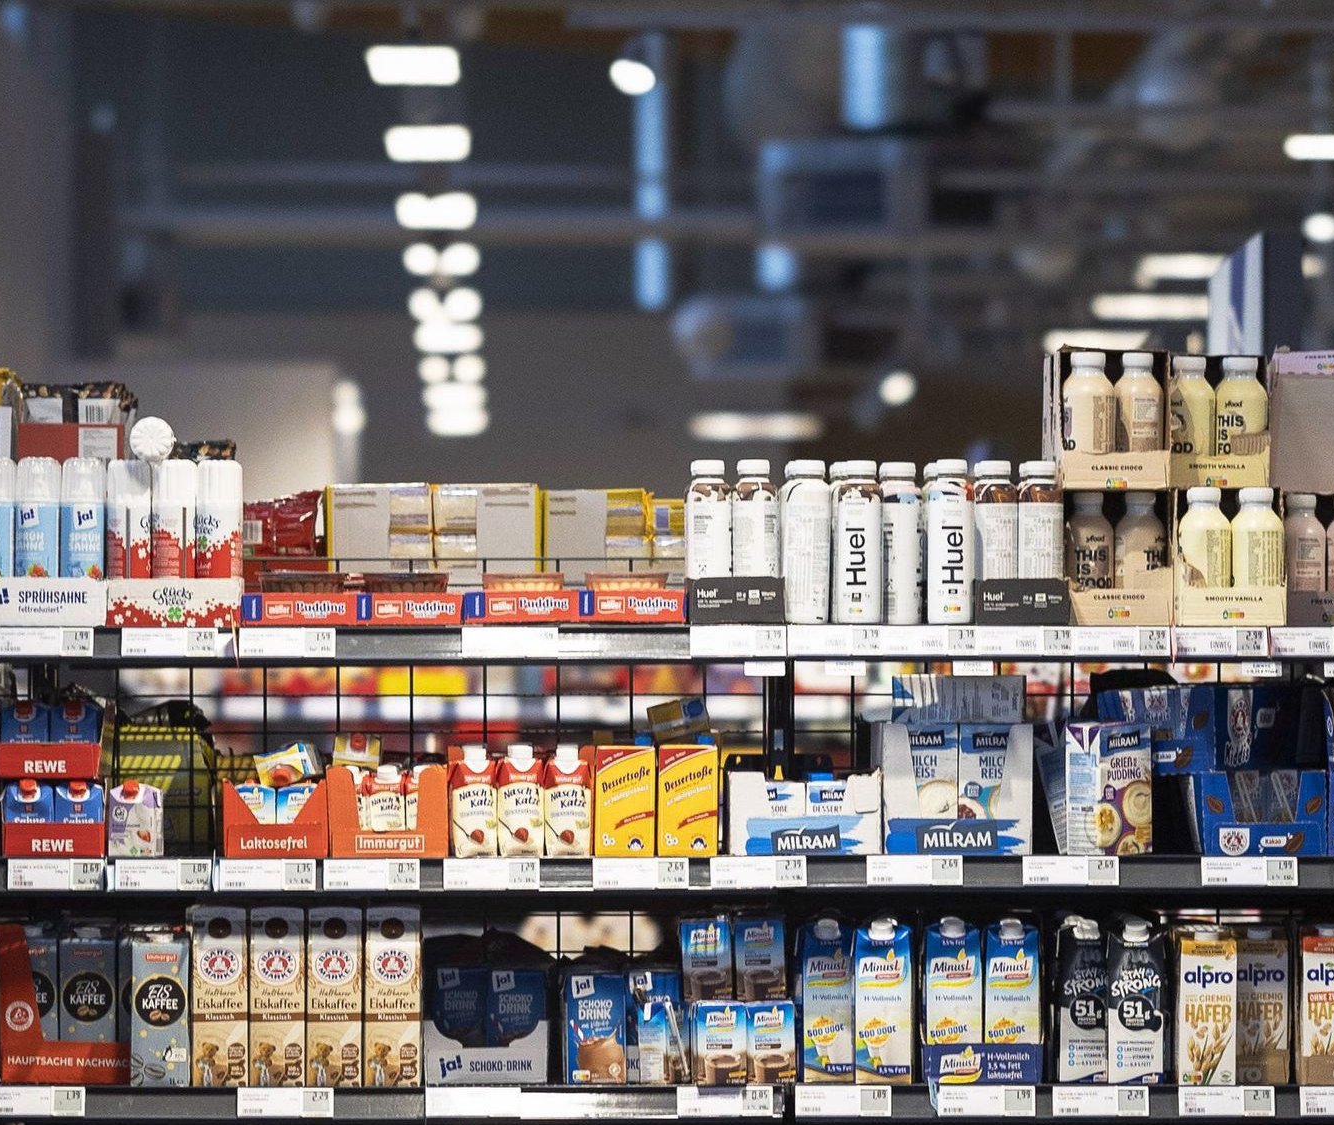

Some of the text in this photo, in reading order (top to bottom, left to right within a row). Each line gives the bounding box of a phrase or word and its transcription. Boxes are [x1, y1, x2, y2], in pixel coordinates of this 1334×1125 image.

[1218, 416, 1244, 427] THIS
[846, 527, 866, 586] Huel
[942, 526, 964, 584] Huel
[18, 588, 88, 604] SPRÜHSAHNE
[697, 588, 718, 599] Huel
[405, 601, 455, 615] Pudding
[1108, 736, 1138, 750] MILRAM
[24, 760, 67, 774] REWE
[1107, 766, 1141, 781] PUDDING
[601, 766, 651, 793] Dessertsoße
[458, 788, 486, 801] Nasch
[31, 838, 74, 852] REWE
[239, 836, 308, 851] Laktosefrei
[359, 838, 421, 851] Immergut
[777, 833, 837, 851] MILRAM
[923, 830, 993, 849] MILRAM
[862, 960, 901, 973] MinusL
[933, 959, 972, 973] MinusL
[992, 959, 1030, 973] MinusL
[1183, 965, 1233, 989] alpro
[1111, 975, 1162, 998] STRONG
[69, 993, 106, 1005] KAFFEE
[141, 998, 178, 1011] KAFFEE
[197, 998, 243, 1010] Eiskaffee
[254, 998, 300, 1010] Eiskaffee
[311, 998, 358, 1010] Eiskaffee
[369, 998, 416, 1010] Eiskaffee
[577, 1000, 613, 1011] SCHOKO
[577, 1009, 611, 1020] DRINK
[1075, 1000, 1097, 1017] 51
[1123, 1001, 1145, 1017] 51
[1184, 1003, 1232, 1024] HAFER
[205, 1013, 235, 1022] Klassisch
[262, 1013, 292, 1022] Klassisch
[319, 1013, 349, 1022] Klassisch
[377, 1013, 407, 1022] Klassisch
[7, 1056, 131, 1068] HAUPTSACHE NACHWAC
[987, 1052, 1030, 1062] H-Vollmilch
